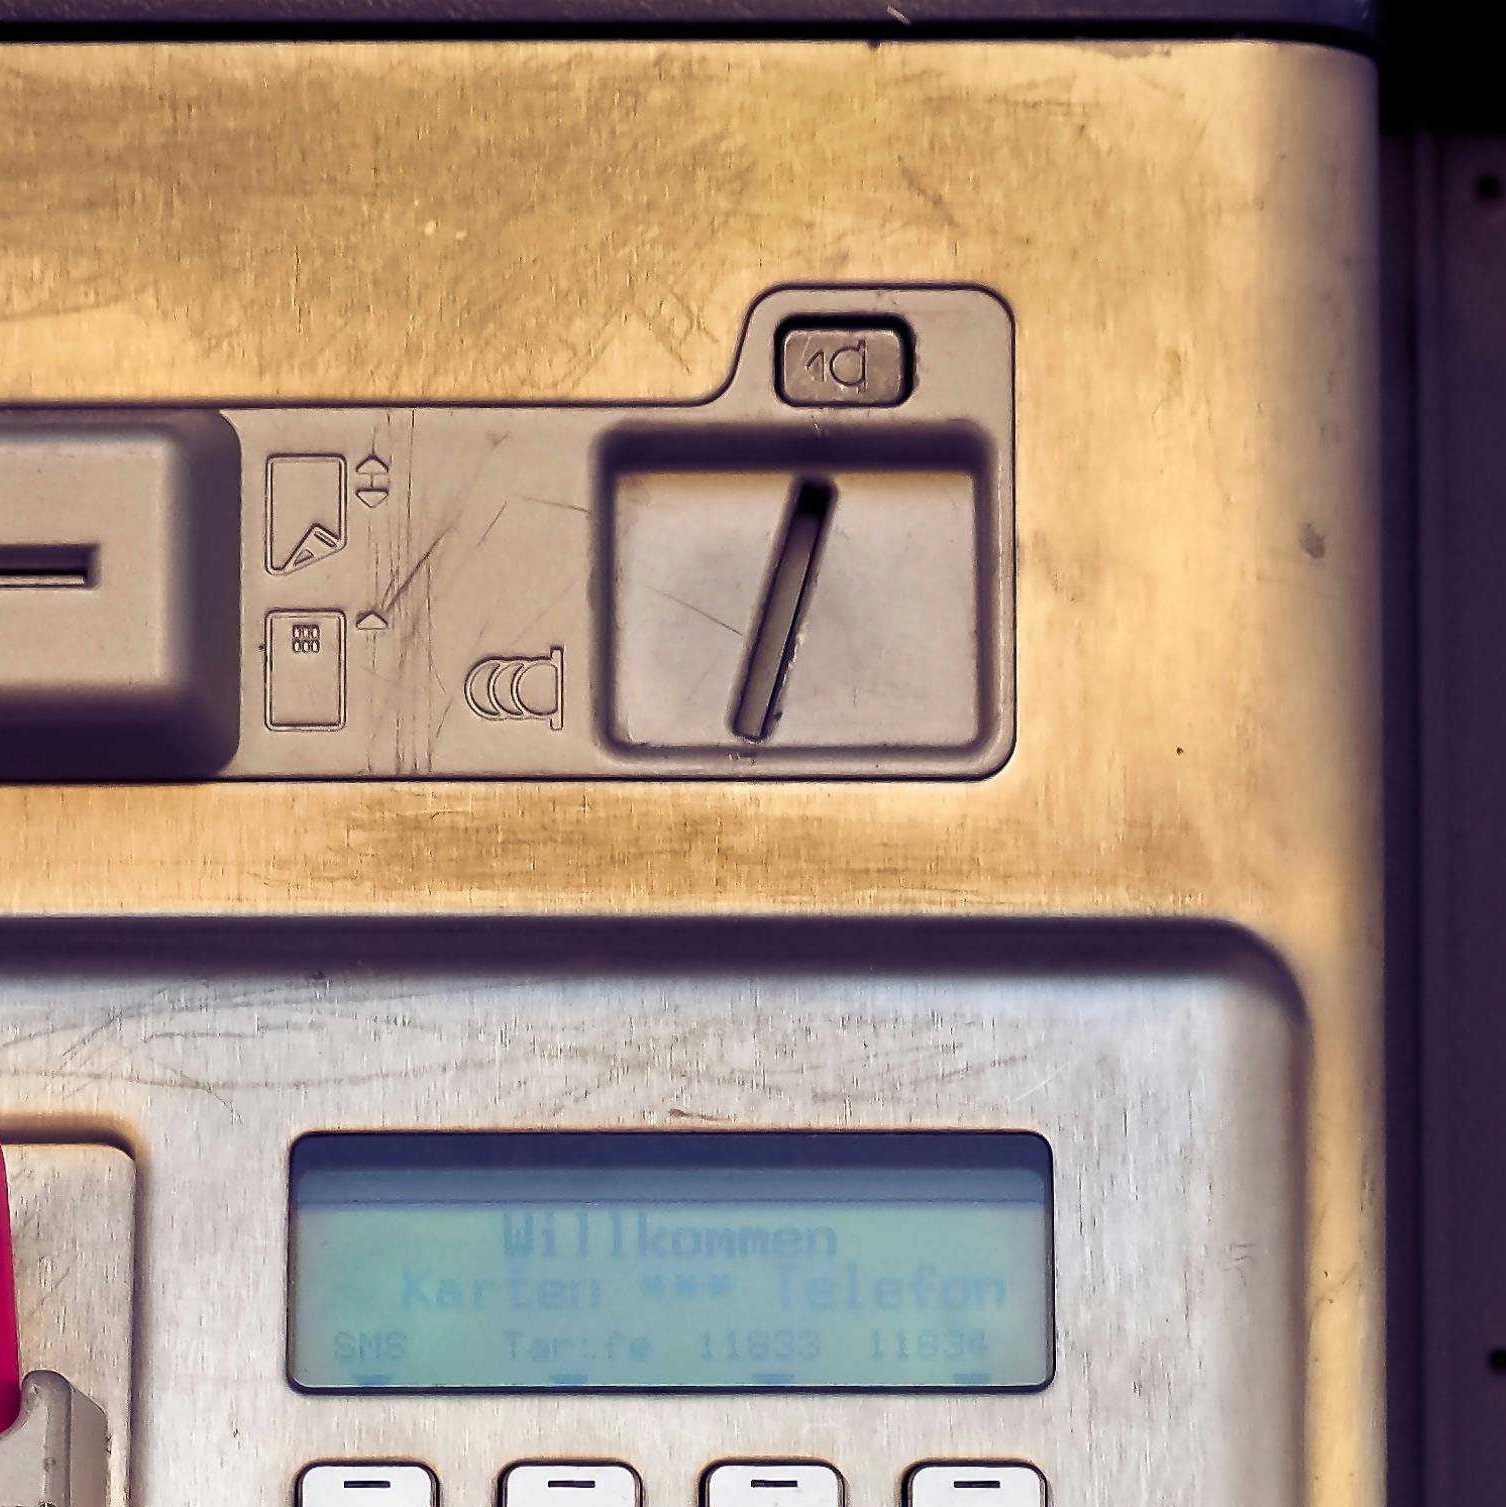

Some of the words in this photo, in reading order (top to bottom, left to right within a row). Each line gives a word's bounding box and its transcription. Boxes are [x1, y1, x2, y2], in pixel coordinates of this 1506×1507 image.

[501, 1209, 838, 1259] Willkommen
[401, 1267, 602, 1311] Karten
[775, 1266, 1006, 1311] Telefon
[333, 1330, 408, 1362] SMS
